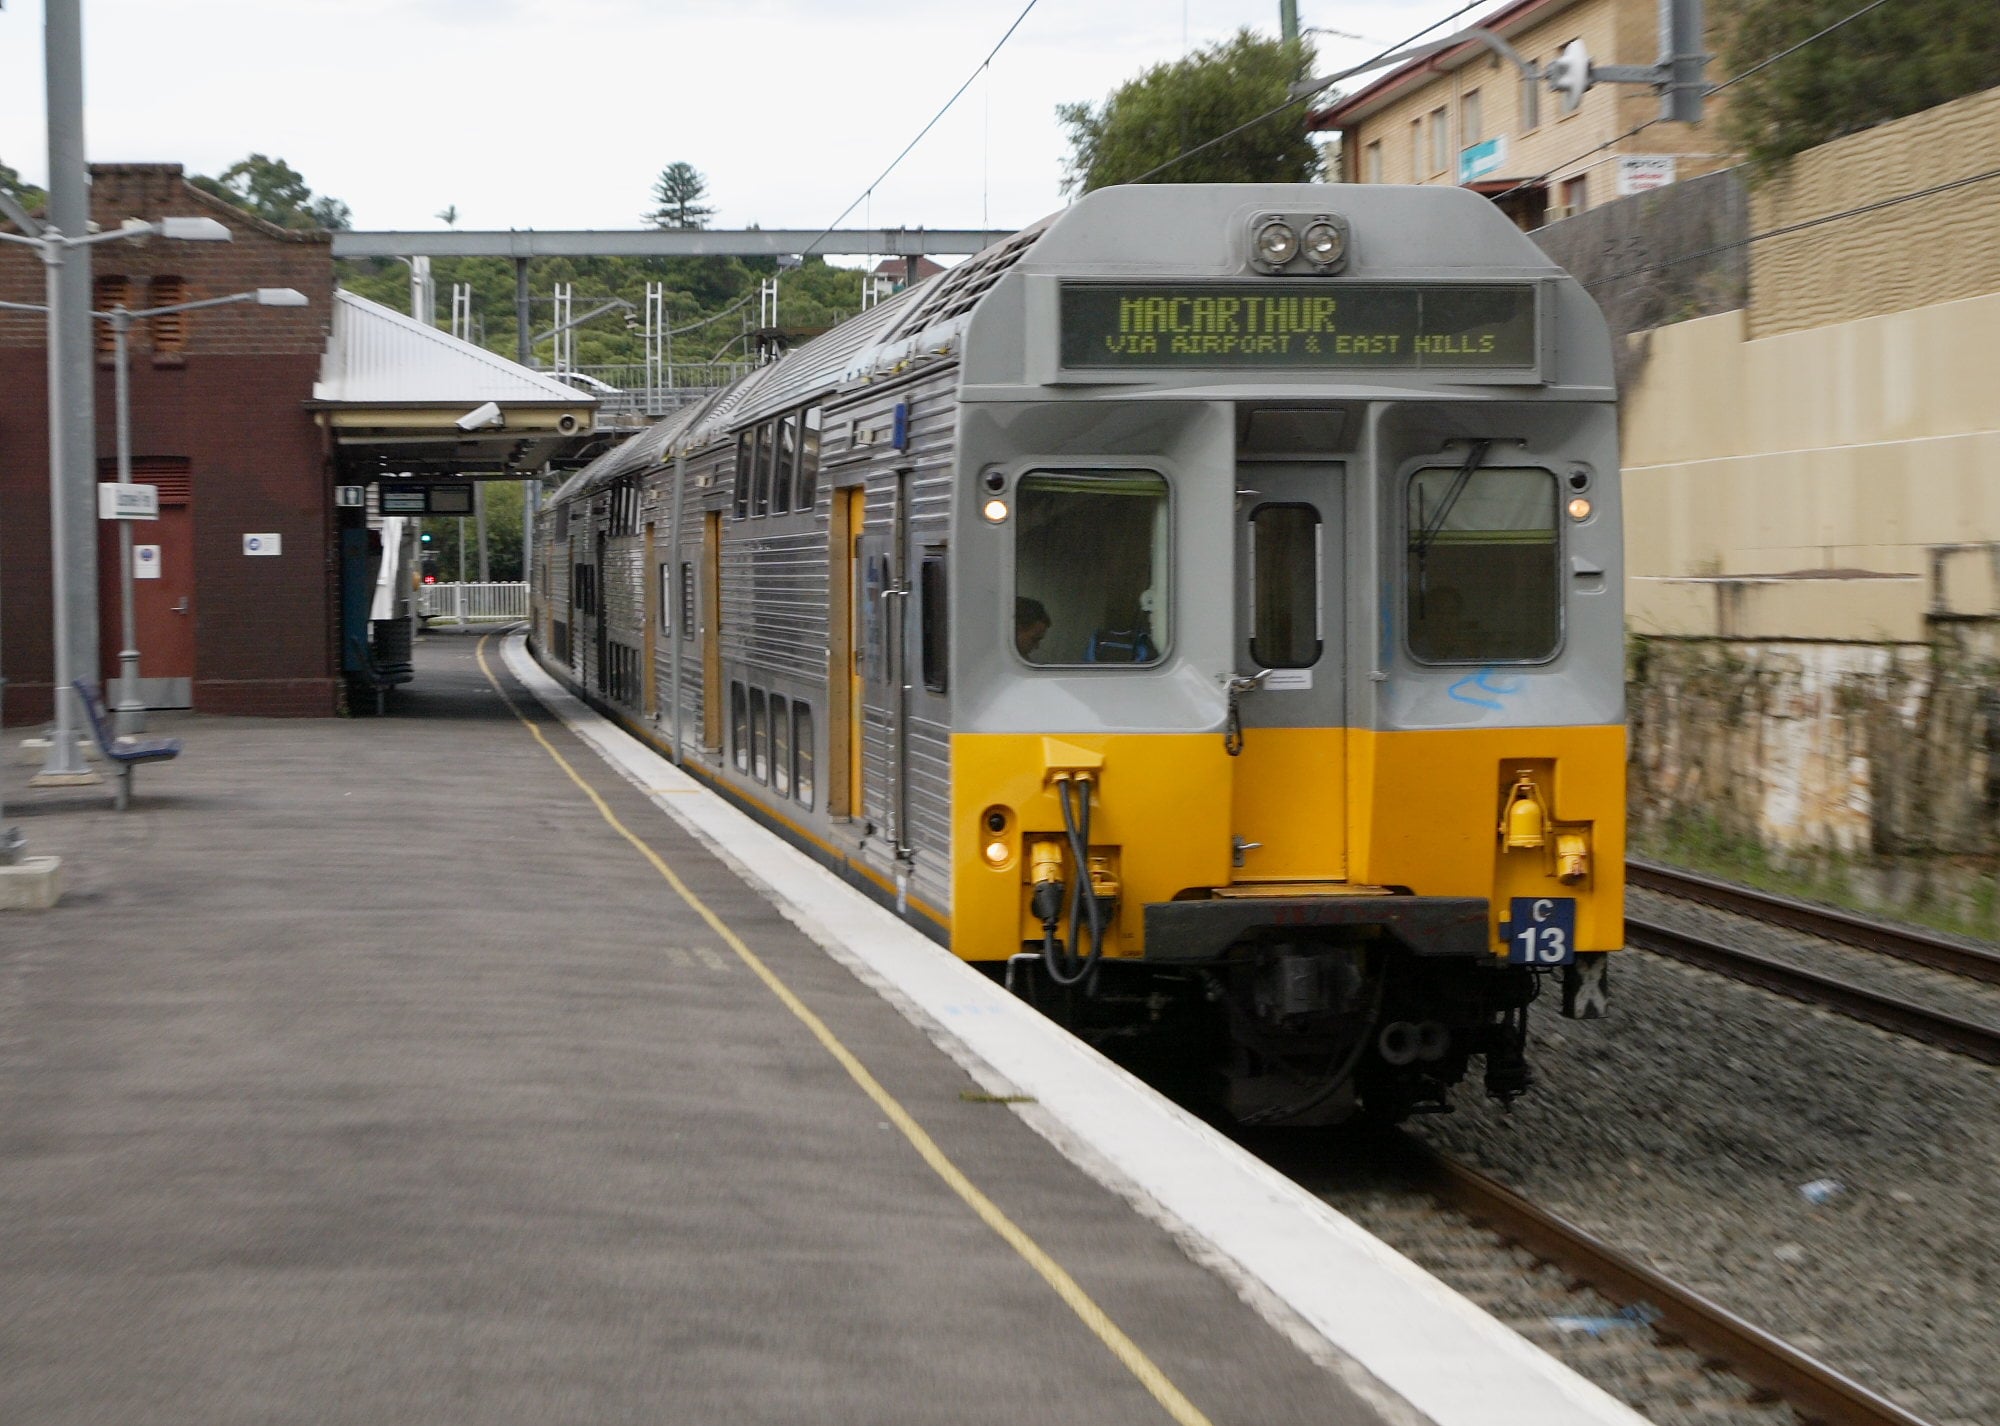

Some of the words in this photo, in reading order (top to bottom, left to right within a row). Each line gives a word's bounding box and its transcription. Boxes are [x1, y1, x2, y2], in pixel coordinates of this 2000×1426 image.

[1120, 297, 1336, 333] MACARTHUR
[1105, 335, 1158, 353] VIA
[1171, 335, 1290, 353] AIRPORT
[1305, 335, 1321, 353] &
[1335, 335, 1400, 353] EAST
[1413, 335, 1496, 353] HILLS
[1532, 898, 1554, 923] C
[1517, 927, 1567, 962] 13
